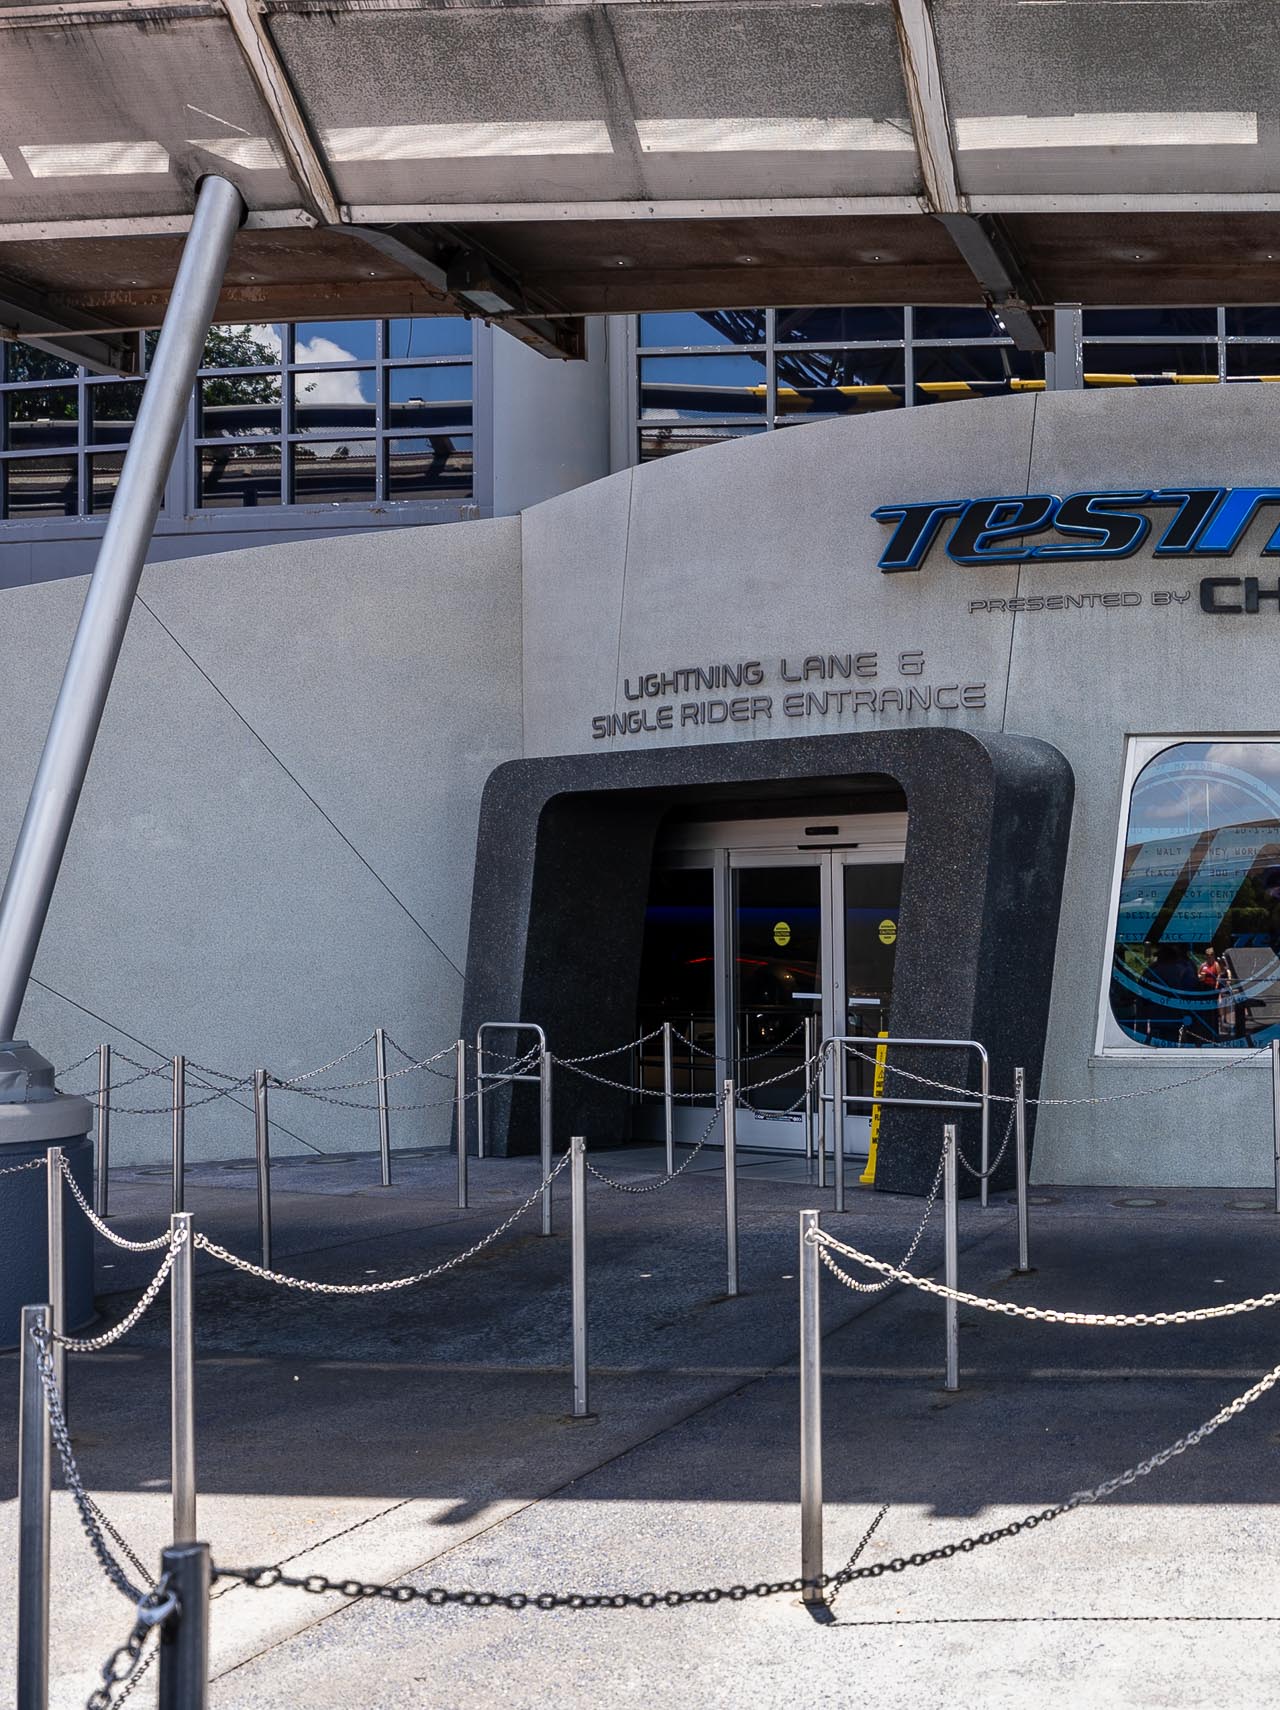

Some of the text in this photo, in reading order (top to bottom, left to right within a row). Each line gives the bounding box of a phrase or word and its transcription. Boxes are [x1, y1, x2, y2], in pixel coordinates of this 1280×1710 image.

[967, 590, 1193, 614] PRESENTED BY
[624, 650, 924, 701] LIGHTNING LANE &
[591, 682, 987, 739] SINGLE RIDER ENTRANCE
